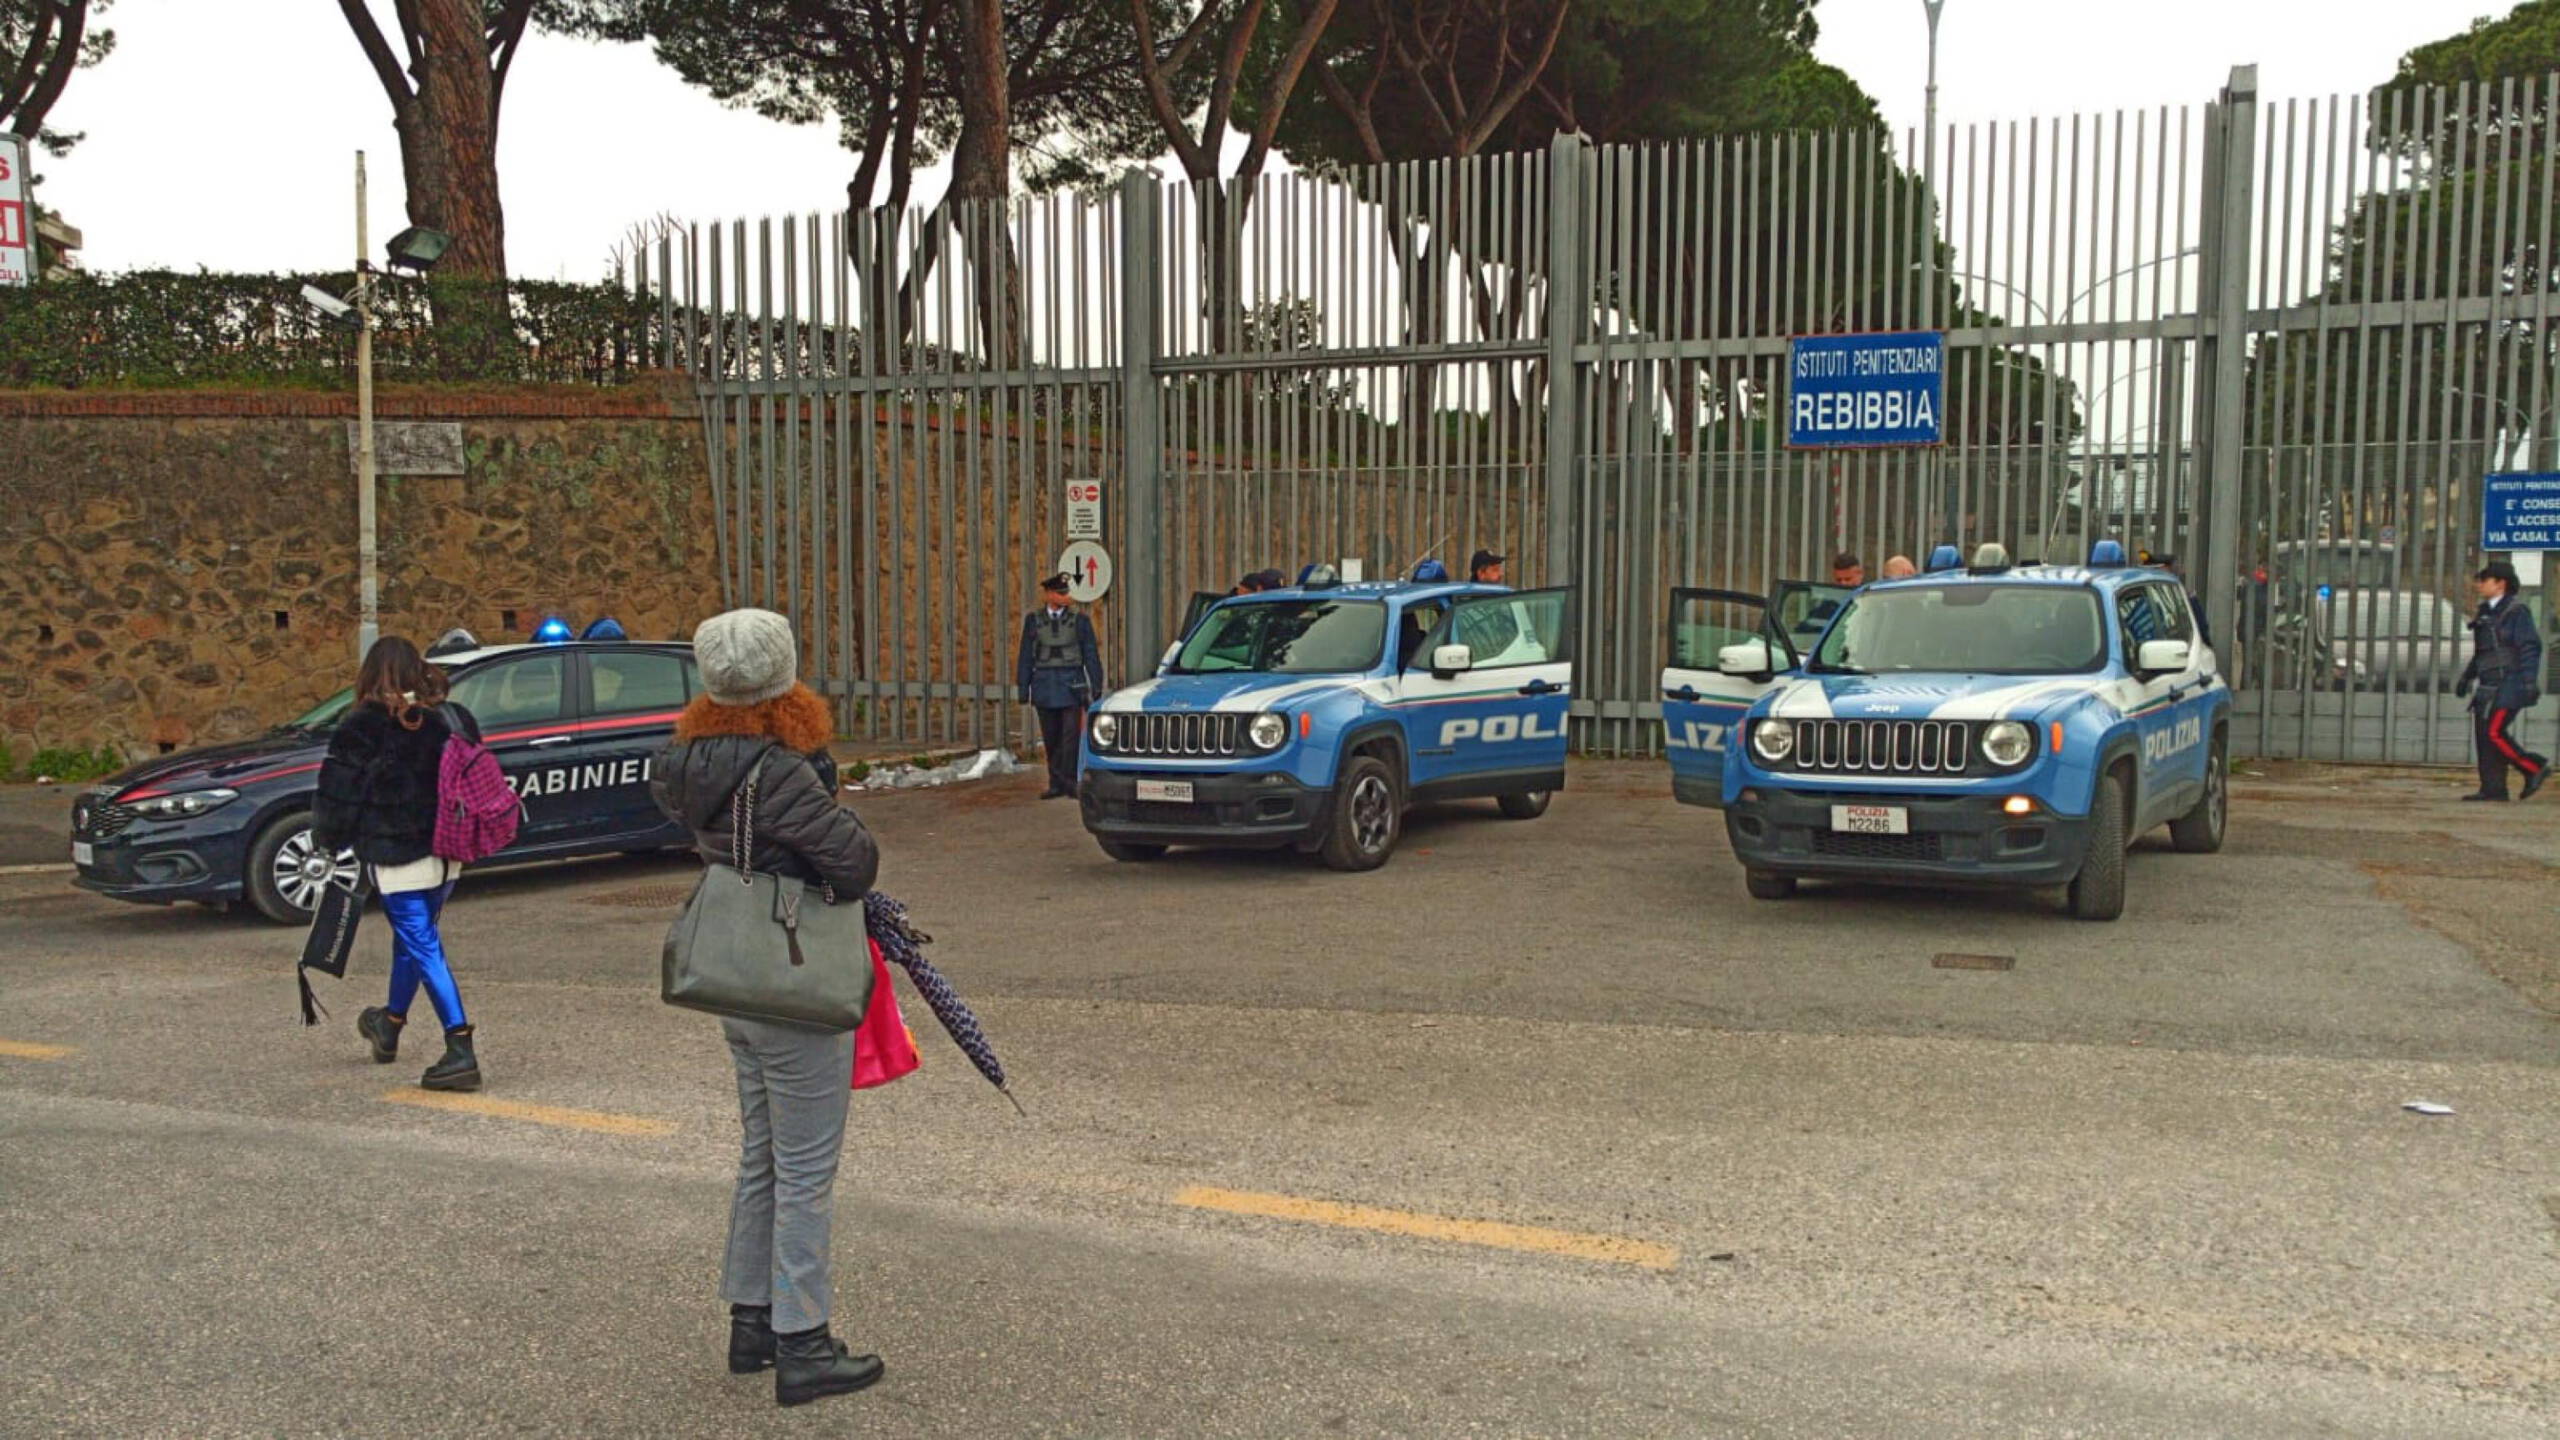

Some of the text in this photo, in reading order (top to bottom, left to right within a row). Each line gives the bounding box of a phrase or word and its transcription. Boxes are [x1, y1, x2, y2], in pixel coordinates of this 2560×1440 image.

[1796, 346, 1938, 377] ISTITUTI PENITENZIARI
[1795, 391, 1934, 431] REBIBBIA
[2488, 531, 2508, 543] VIA
[2512, 531, 2550, 543] CASAL
[2145, 715, 2200, 766] POLIZIA
[1847, 806, 1889, 817] POLIZIA
